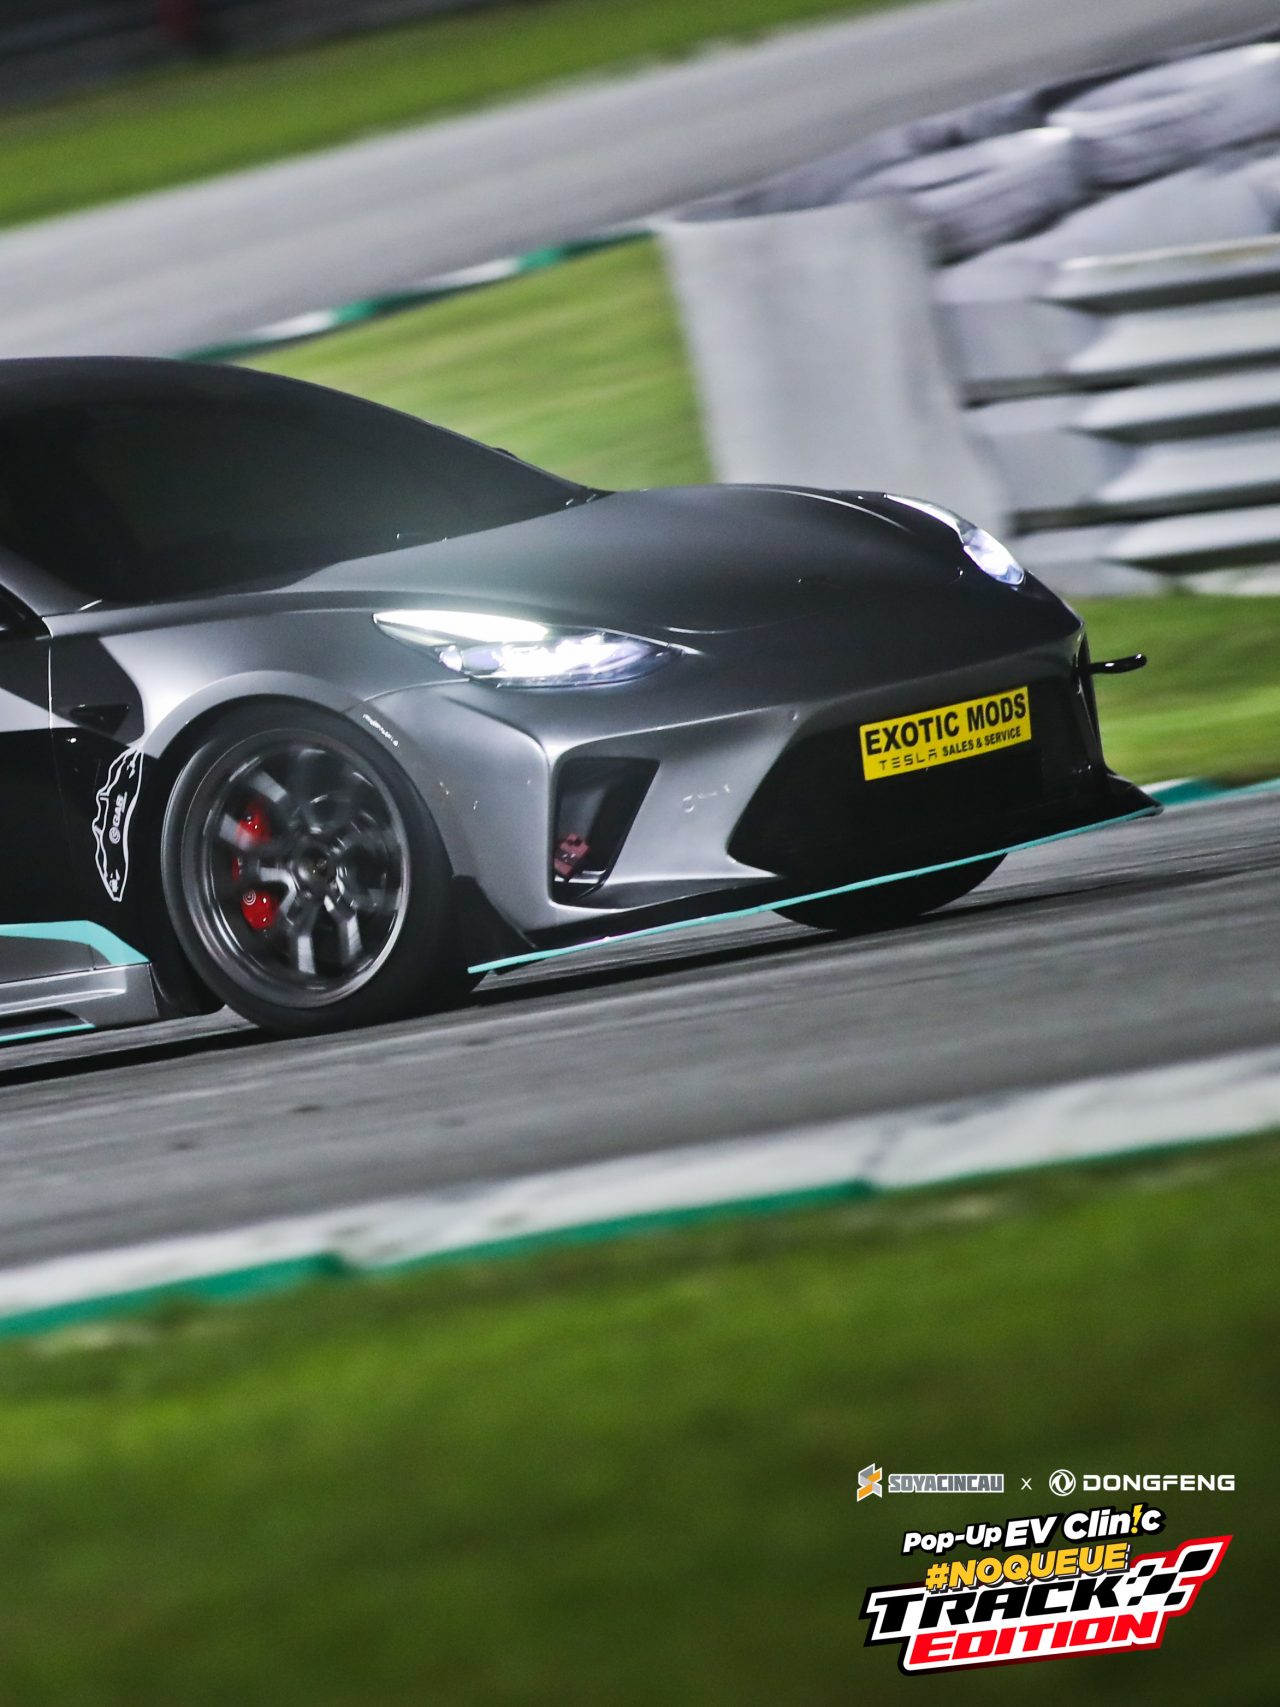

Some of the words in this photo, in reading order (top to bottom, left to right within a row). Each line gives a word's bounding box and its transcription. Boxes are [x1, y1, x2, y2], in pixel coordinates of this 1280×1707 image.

[865, 711, 960, 756] EXOTIC
[966, 693, 1027, 732] MODS
[879, 748, 938, 771] TESLA
[942, 739, 974, 757] SALES
[976, 738, 983, 748] &
[984, 726, 1022, 747] SERVICE
